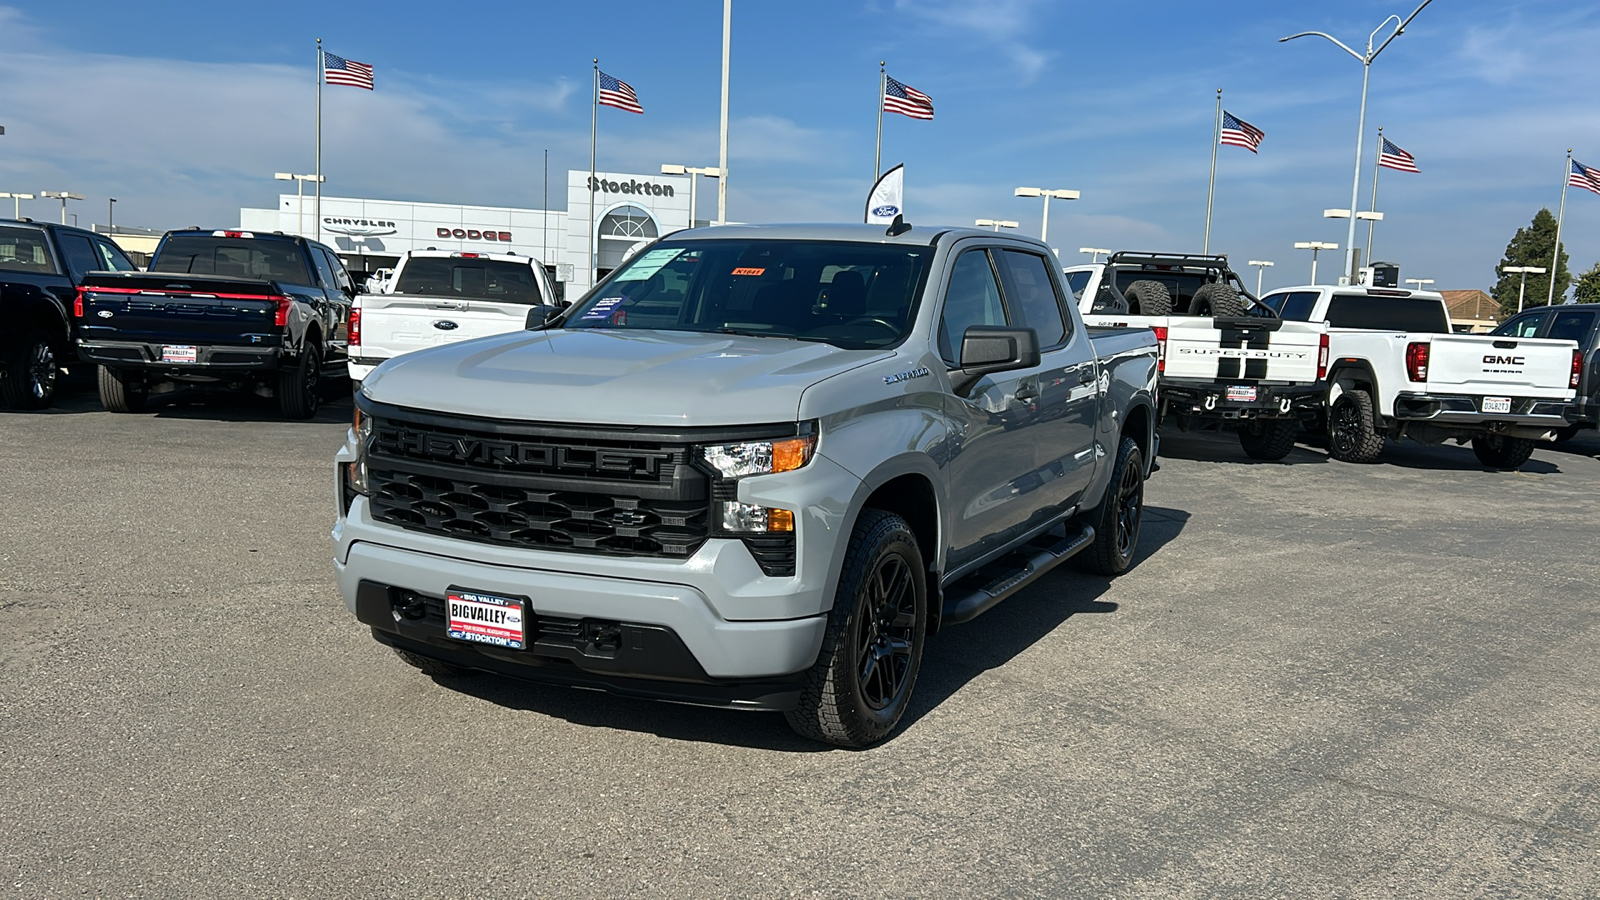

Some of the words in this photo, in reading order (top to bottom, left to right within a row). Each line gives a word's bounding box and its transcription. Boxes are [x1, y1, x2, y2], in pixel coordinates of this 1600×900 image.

[587, 176, 675, 197] Stockton
[323, 217, 396, 228] CHRYSLER
[436, 227, 512, 242] DODGE
[1179, 348, 1249, 357] SUPER
[1255, 351, 1307, 359] DUTY
[1482, 355, 1525, 366] GMC
[376, 427, 672, 475] CHEVROLET
[478, 597, 504, 605] VALLEY
[451, 603, 507, 624] BIGVALLEY
[465, 632, 507, 646] STOCKTON
